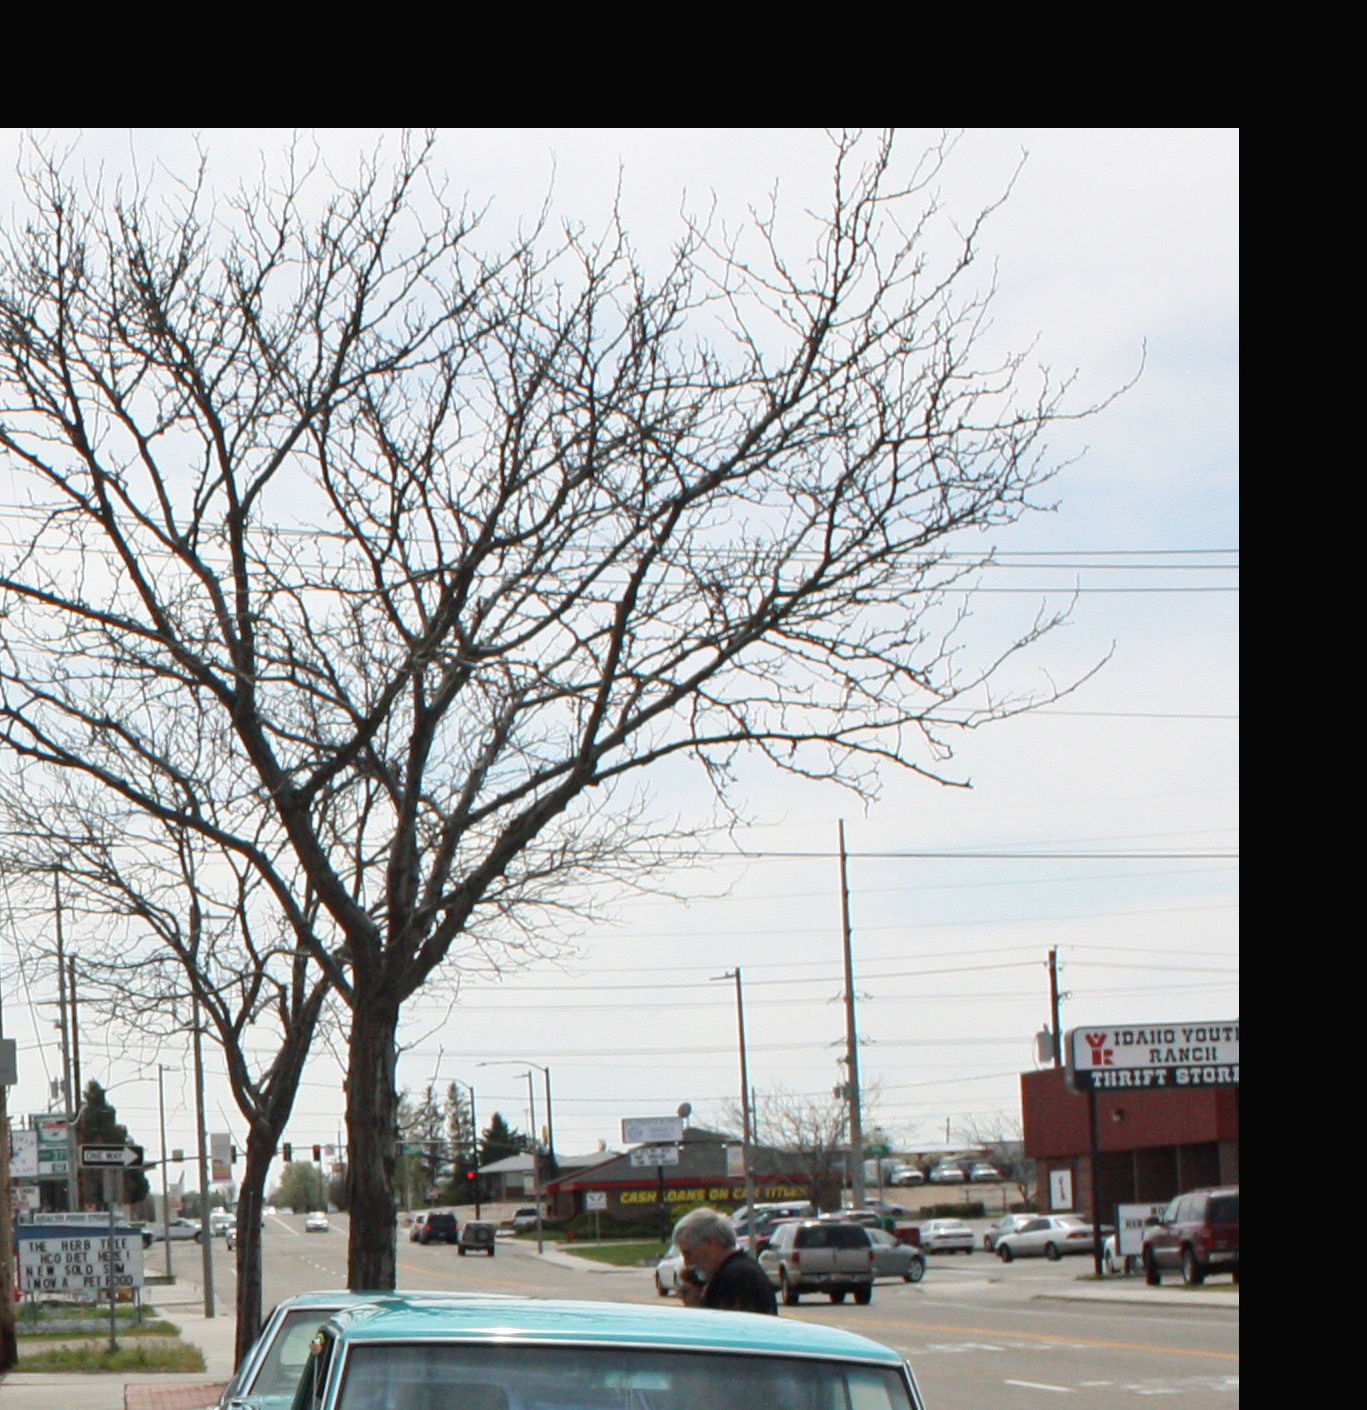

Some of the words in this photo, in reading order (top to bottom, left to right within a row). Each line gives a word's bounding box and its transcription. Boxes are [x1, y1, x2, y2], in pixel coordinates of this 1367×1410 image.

[1114, 1030, 1176, 1046] IDAHO
[1149, 1047, 1217, 1064] RANCH
[1091, 1069, 1167, 1088] THRIFT
[86, 1151, 101, 1160] ONE
[106, 1151, 123, 1160] WAY
[620, 1191, 657, 1204] CASH
[709, 1187, 729, 1200] ON
[29, 1241, 47, 1252] THE
[61, 1240, 91, 1251] HERB
[66, 1251, 87, 1263] DIET
[26, 1265, 55, 1277] NEW
[65, 1264, 93, 1276] SOLO
[84, 1276, 101, 1288] PET
